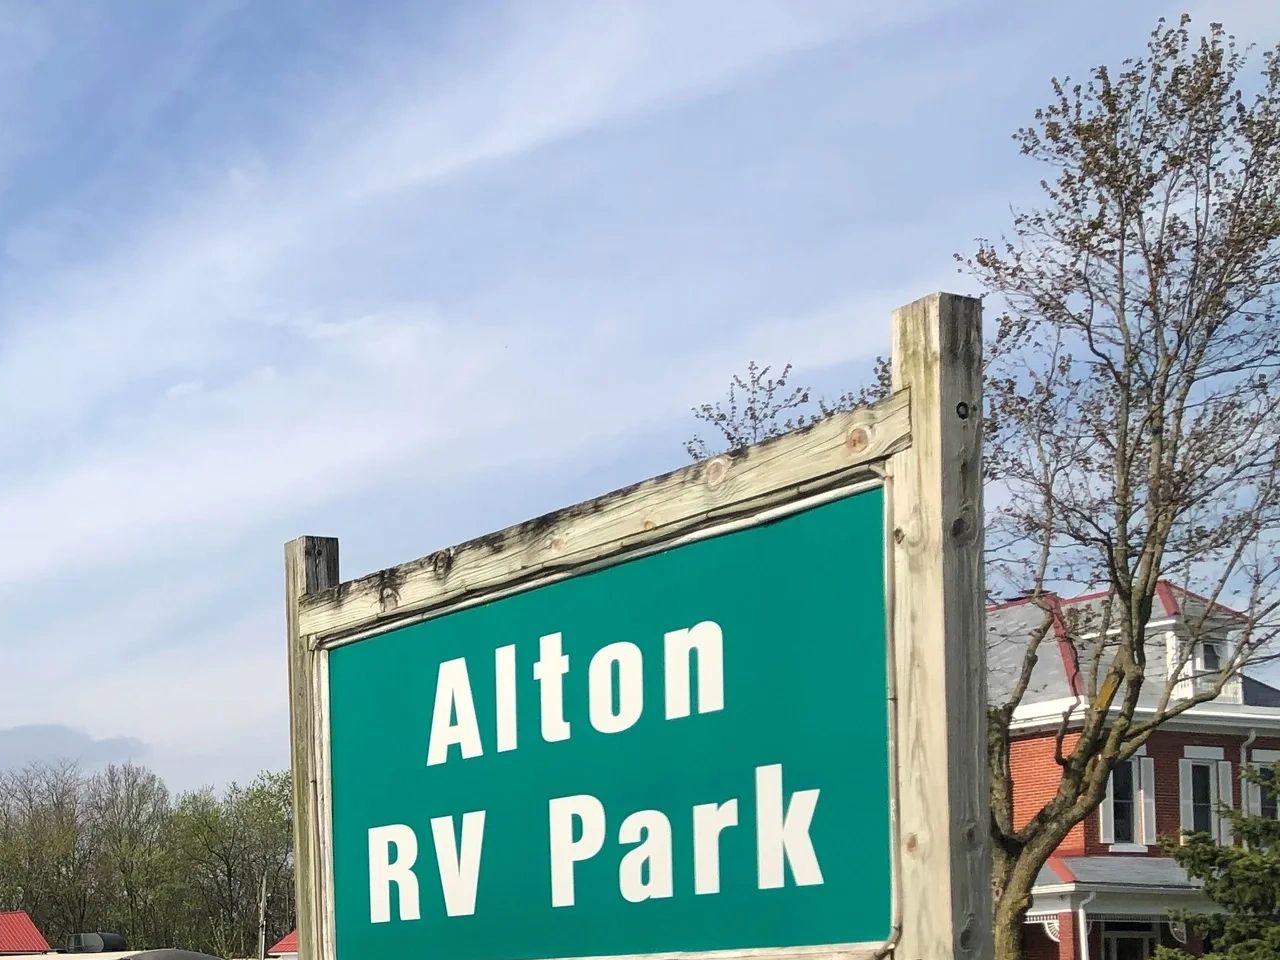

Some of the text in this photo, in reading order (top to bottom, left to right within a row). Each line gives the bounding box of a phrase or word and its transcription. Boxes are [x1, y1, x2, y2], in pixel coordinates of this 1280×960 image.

[427, 620, 724, 767] Alton
[368, 763, 824, 924] RV Park
